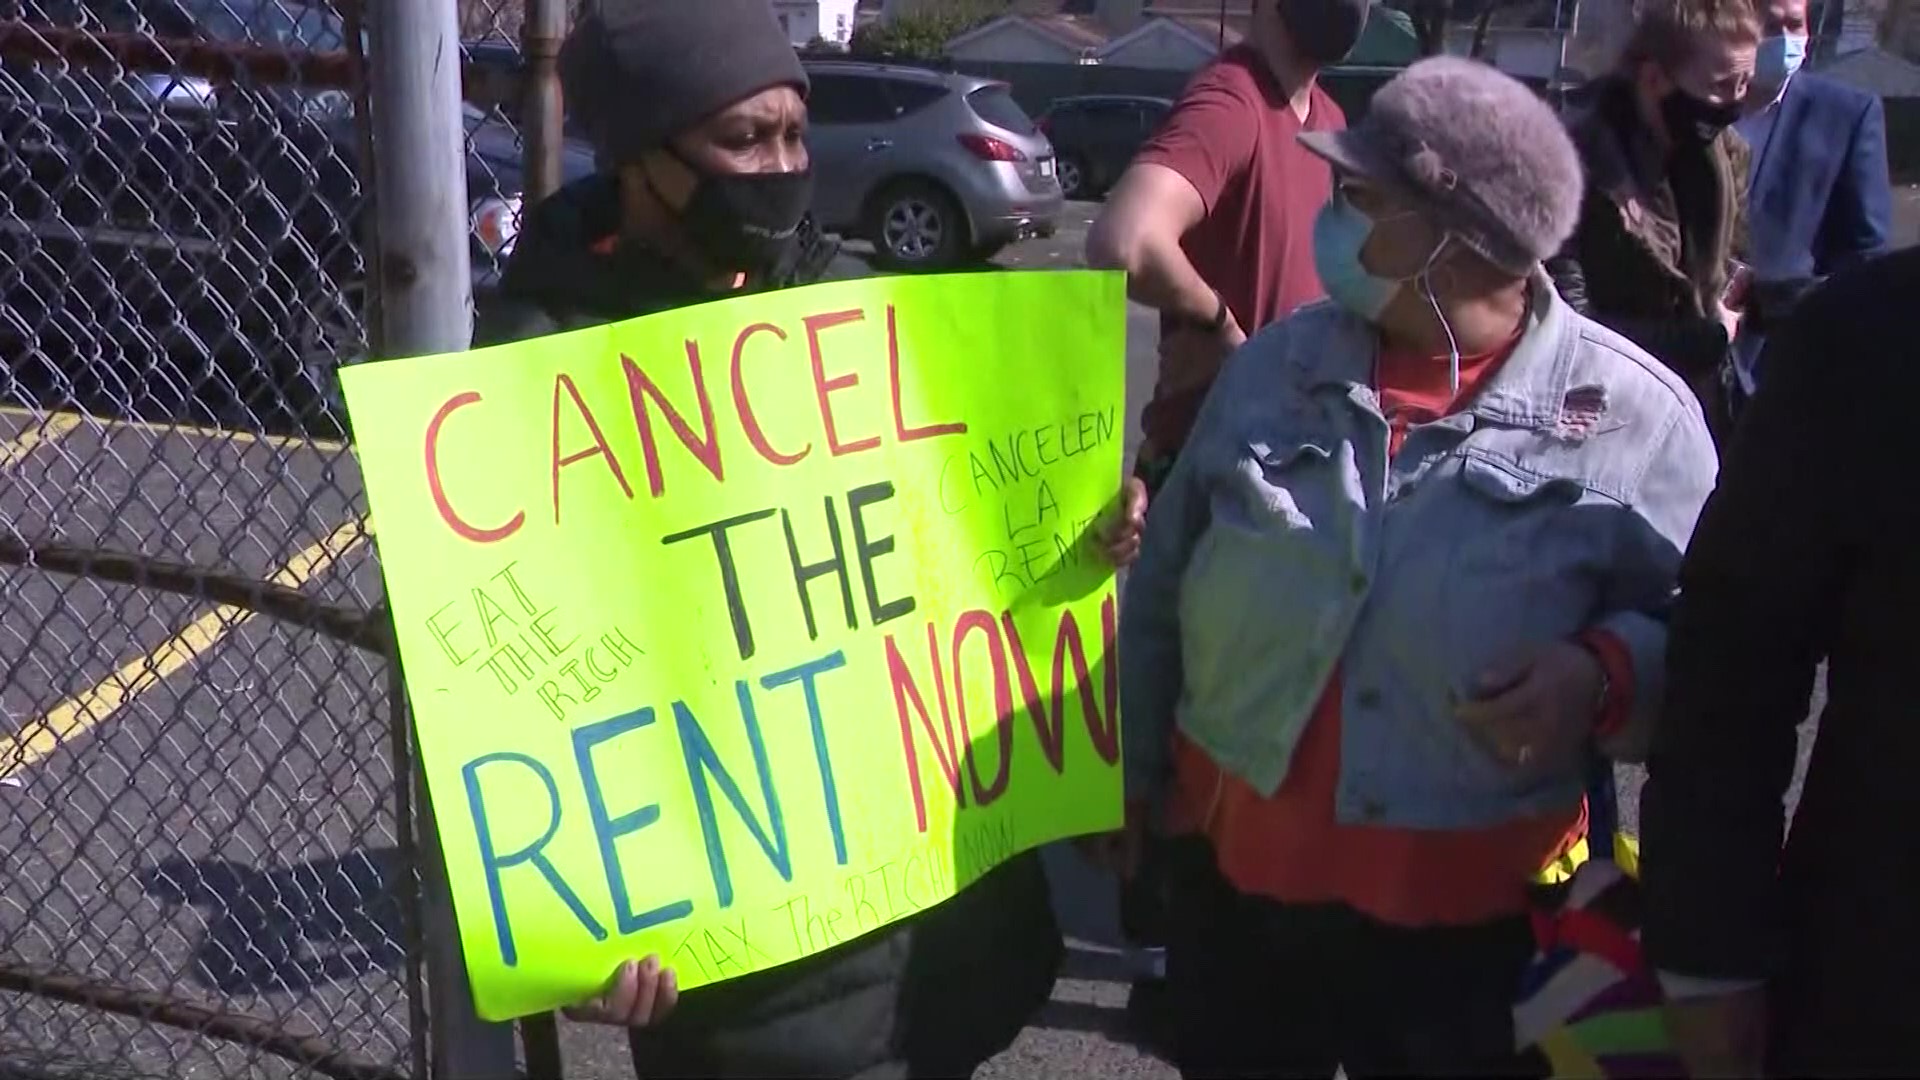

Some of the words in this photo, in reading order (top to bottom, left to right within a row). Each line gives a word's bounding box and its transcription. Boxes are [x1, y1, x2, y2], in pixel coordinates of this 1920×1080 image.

[424, 304, 967, 544] CANCEL
[940, 404, 1115, 515] CANCELEN
[1004, 479, 1060, 539] LA
[425, 560, 538, 667] EAT
[661, 480, 915, 661] THE
[476, 606, 582, 695] THE
[536, 626, 646, 722] RICH
[462, 650, 848, 967] RENT
[884, 592, 1119, 833] NOW
[673, 917, 773, 981] TAX
[844, 847, 948, 925] RICH
